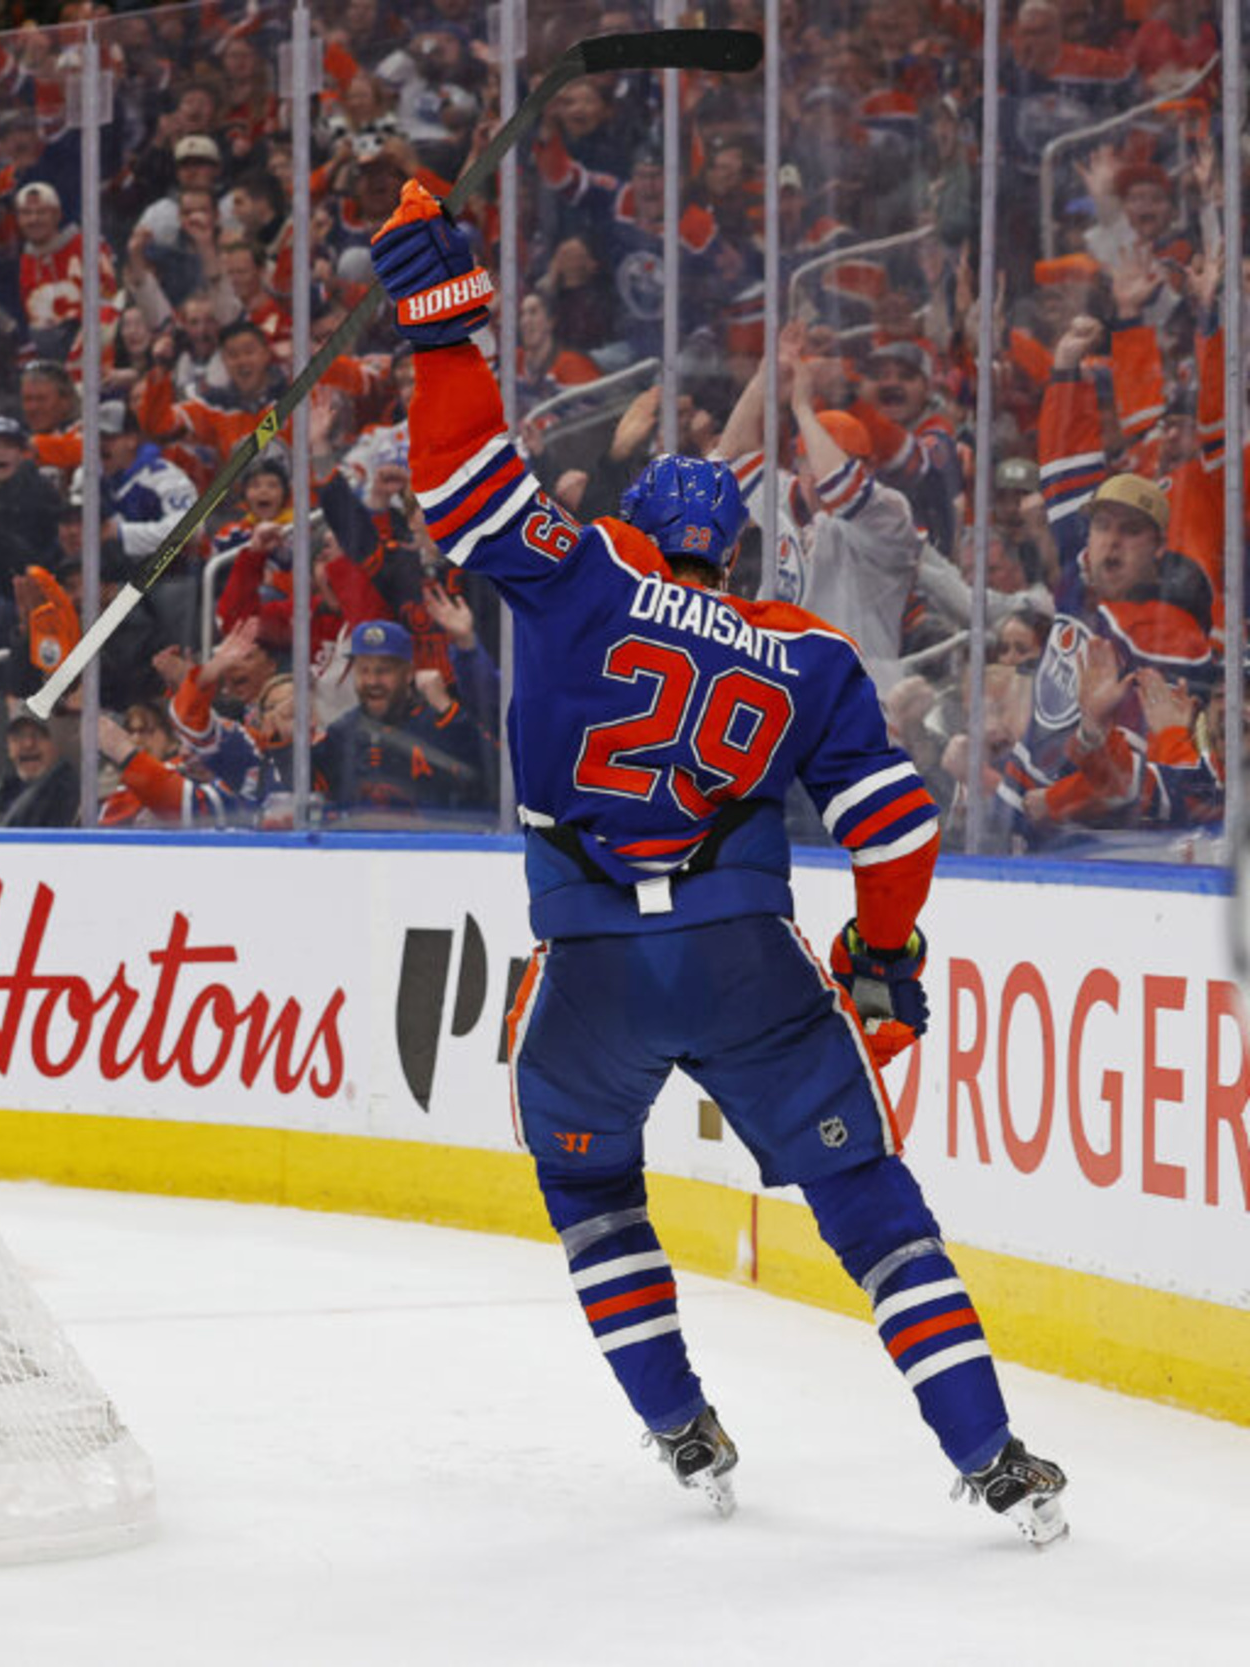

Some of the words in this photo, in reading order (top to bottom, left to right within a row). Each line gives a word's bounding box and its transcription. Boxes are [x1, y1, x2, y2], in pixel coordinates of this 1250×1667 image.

[682, 526, 712, 550] 29
[630, 574, 799, 676] DRAISAITL
[573, 634, 795, 820] 29
